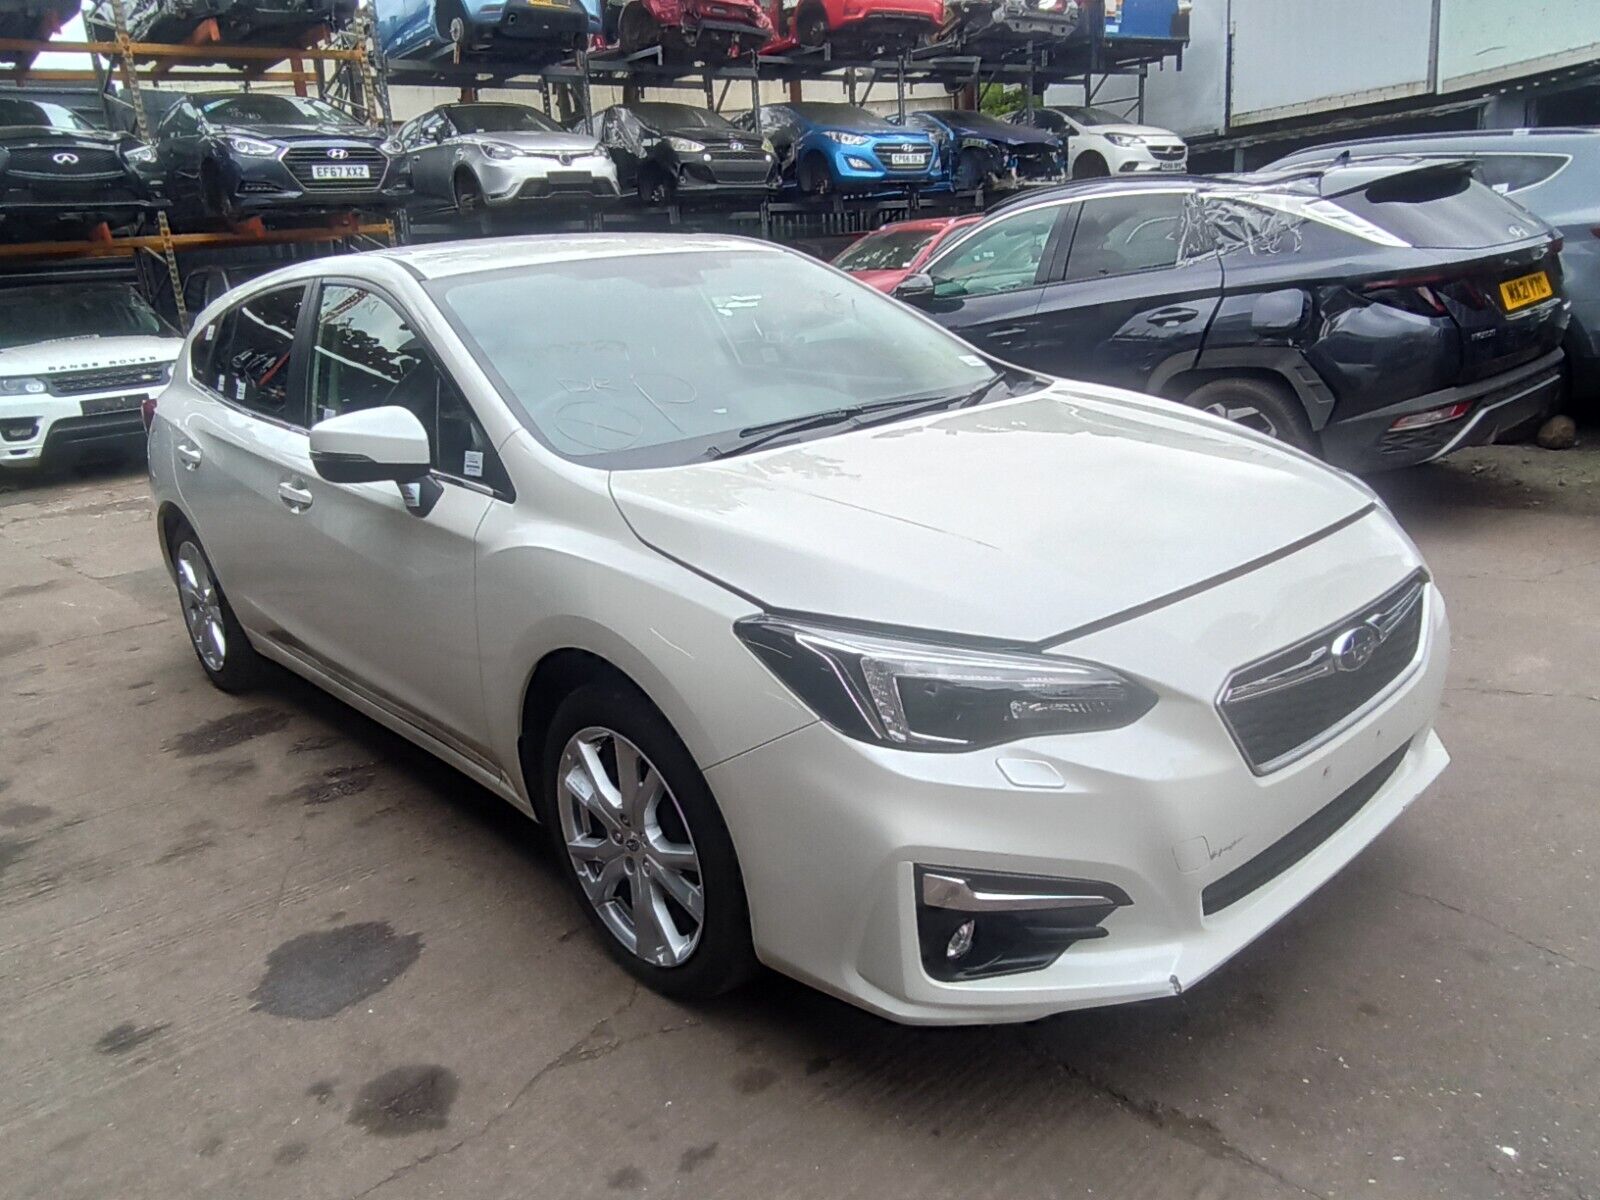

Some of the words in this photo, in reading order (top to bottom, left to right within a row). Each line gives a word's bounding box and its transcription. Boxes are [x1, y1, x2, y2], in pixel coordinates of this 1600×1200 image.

[316, 167, 343, 177] EF67
[345, 167, 365, 177] XXZ
[48, 362, 99, 371] RANGE
[109, 356, 157, 365] ROVER
